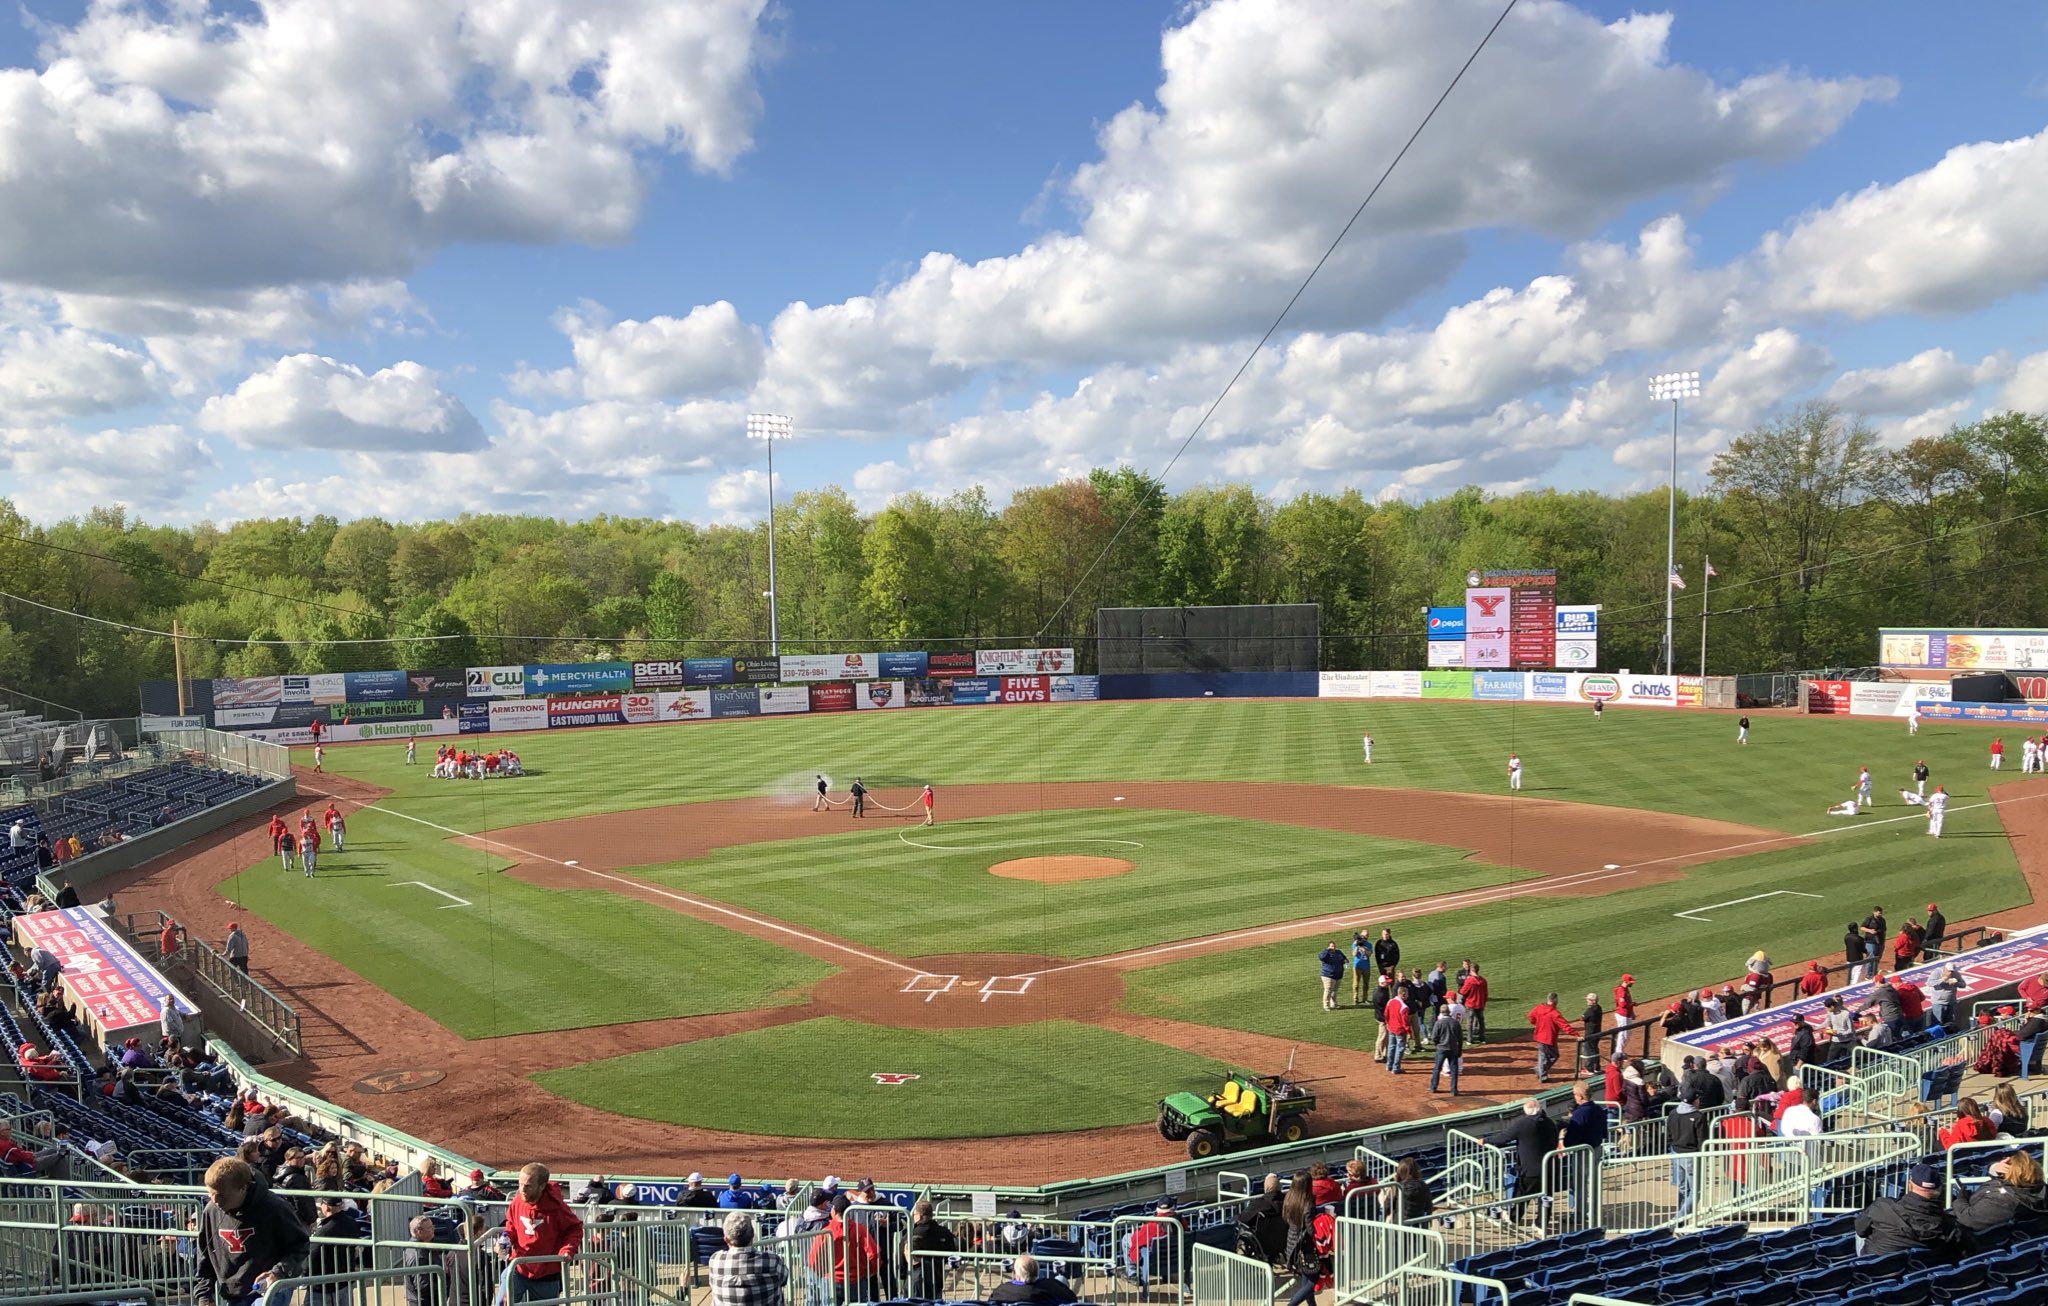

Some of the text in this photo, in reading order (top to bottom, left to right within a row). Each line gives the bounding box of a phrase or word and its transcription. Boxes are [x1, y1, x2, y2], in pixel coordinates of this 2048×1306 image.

[1483, 576, 1556, 586] SCRAPPERS
[1472, 595, 1505, 617] Y
[1564, 613, 1589, 622] BUD
[1441, 619, 1464, 628] pepsi
[1560, 622, 1594, 631] LIGHT
[1497, 626, 1504, 639] 9
[977, 650, 1024, 664] KNIGHTLINE
[634, 661, 683, 676] BERK
[782, 668, 828, 678] 330-726-9841
[552, 670, 626, 681] MERCYHEALTH
[1321, 673, 1368, 681] The Vindicator
[1535, 675, 1563, 685] Tribune
[1008, 677, 1040, 689] FIVE
[1483, 681, 1523, 689] FARMERS
[1584, 684, 1617, 692] ORLANDO
[812, 688, 853, 696] HOLLYWOOD
[1533, 685, 1566, 693] Chronicle
[714, 691, 756, 701] KENT STATE
[912, 695, 946, 703] SPOTLIGHT
[1005, 690, 1044, 702] GUYS
[550, 697, 654, 711] HUNGRY? 30+
[385, 704, 417, 715] CHANCE
[491, 705, 545, 714] ARMSTRONG
[171, 719, 201, 728] FUN ZONE
[551, 714, 597, 726] EASTWOOD
[598, 712, 619, 723] MALL
[374, 722, 433, 735] Huntington
[1752, 1012, 1793, 1026] LOCAL
[637, 1185, 678, 1203] PNC
[519, 1215, 544, 1236] Y
[218, 1227, 255, 1253] Y
